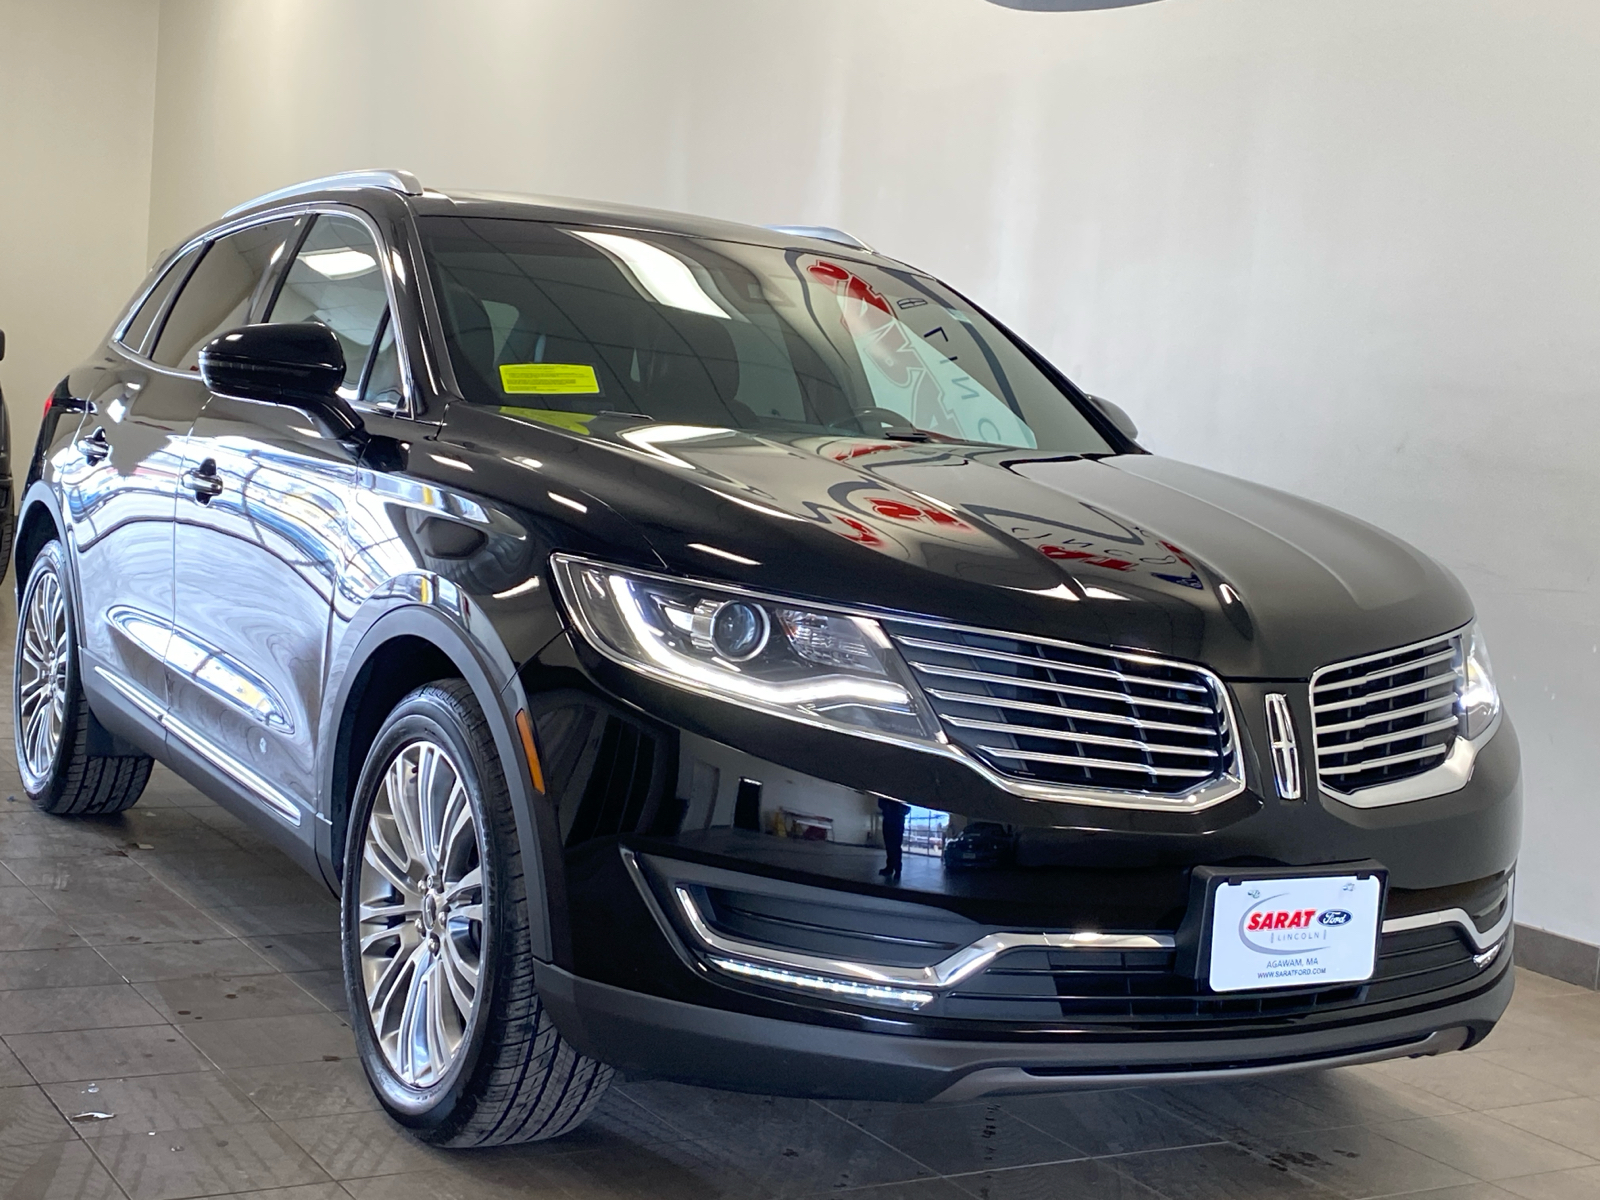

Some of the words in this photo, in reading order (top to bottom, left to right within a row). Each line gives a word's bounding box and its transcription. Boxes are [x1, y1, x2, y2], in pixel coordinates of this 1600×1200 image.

[1247, 909, 1316, 931] SARAT
[1277, 931, 1320, 942] LINCOLN
[1266, 959, 1304, 969] AGAWAM,
[1306, 957, 1319, 966] MA
[1257, 967, 1327, 979] WWW.SARATFORD.COM
